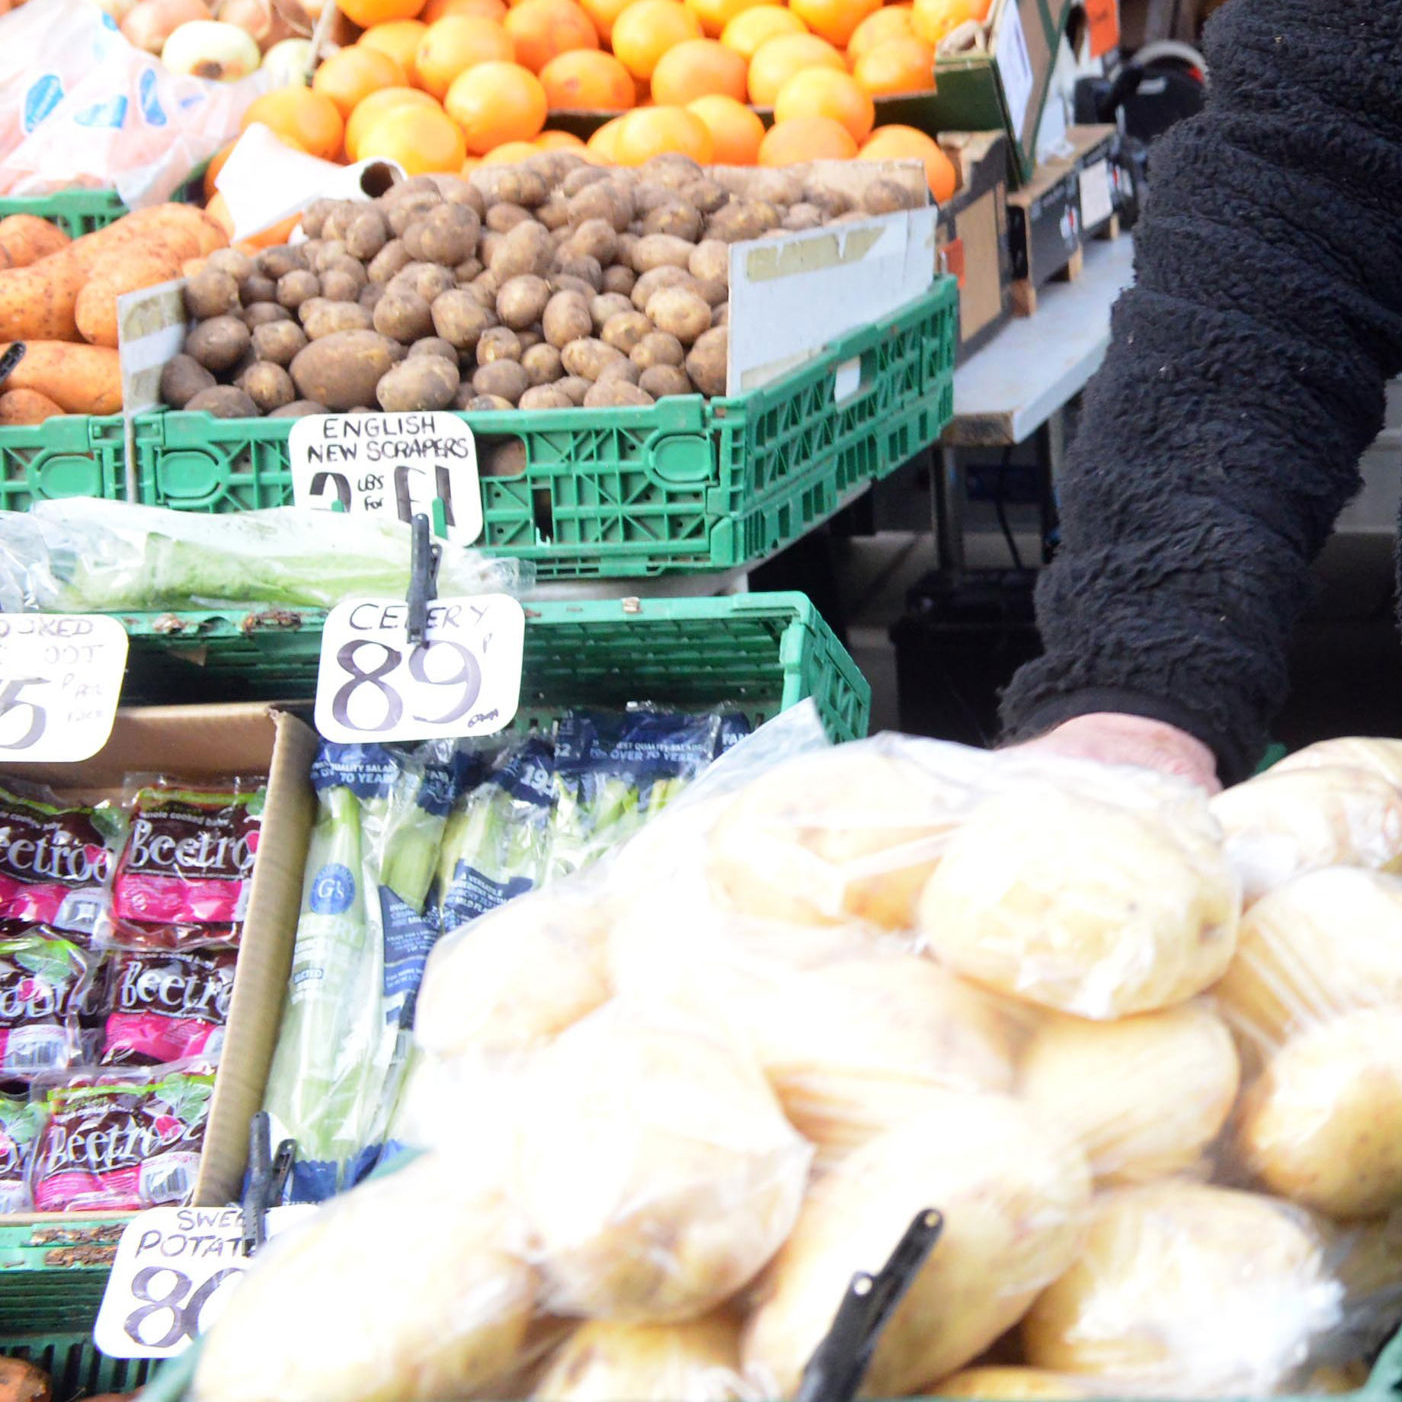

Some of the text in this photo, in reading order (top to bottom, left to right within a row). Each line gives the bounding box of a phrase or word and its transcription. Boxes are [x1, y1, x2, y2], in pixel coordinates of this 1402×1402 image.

[323, 415, 436, 439] ENGLISH
[307, 437, 469, 465] NEW SCRAPERS
[349, 602, 489, 632] CEERY
[332, 638, 483, 733] 89
[0, 676, 52, 750] 5
[365, 763, 398, 774] SALAD
[127, 817, 258, 871] Beetro
[121, 960, 235, 1018] Beetro
[177, 1210, 243, 1231] SWE
[135, 1229, 246, 1259] POTAT
